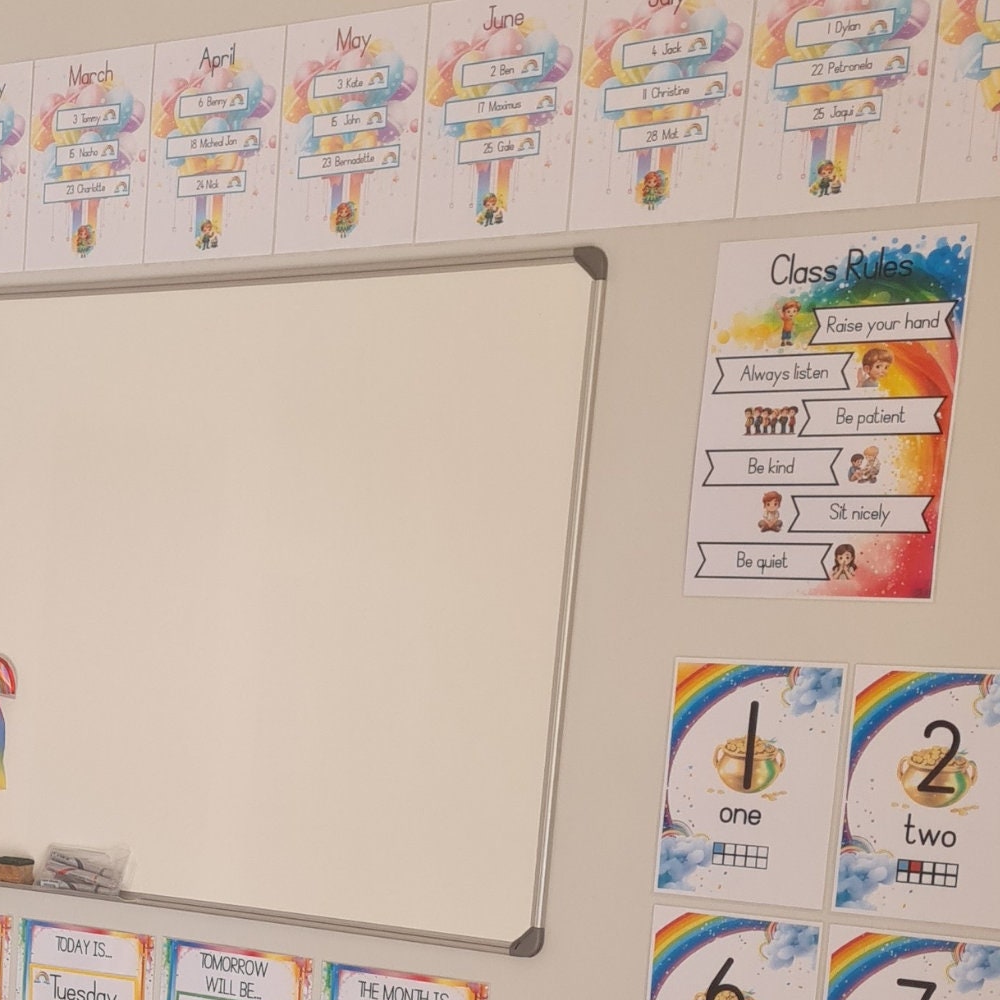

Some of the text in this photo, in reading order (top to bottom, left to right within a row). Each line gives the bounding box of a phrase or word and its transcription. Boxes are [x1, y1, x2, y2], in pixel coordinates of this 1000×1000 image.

[483, 5, 524, 31] June
[835, 20, 861, 36] Dylan
[336, 26, 371, 57] May
[661, 44, 682, 56] Jack
[199, 43, 236, 77] April
[811, 59, 873, 76] 22 Petronela
[69, 60, 113, 87] March
[491, 65, 514, 76] 2 Ben
[337, 77, 363, 89] 3 Kate
[651, 85, 690, 98] Christine
[206, 97, 226, 109] Benny
[489, 100, 522, 111] Maximus
[73, 113, 100, 125] 3 Tommy
[343, 115, 361, 125] John
[813, 108, 825, 120] 25
[646, 130, 658, 142] 28
[322, 154, 375, 168] 23 Bernadette
[206, 180, 219, 189] Nick
[771, 247, 913, 286] Class Rules
[826, 312, 940, 338] Raise your hand
[740, 366, 829, 387] Always listen
[835, 406, 906, 431] Be patient
[748, 458, 795, 474] Be kind
[830, 504, 891, 527] Sit nicely
[737, 552, 788, 575] Be quiet
[743, 701, 759, 790] 1
[917, 720, 961, 794] 2
[719, 807, 762, 825] one
[904, 813, 957, 847] two
[56, 936, 90, 956] TODAY
[200, 952, 268, 977] TOMORROW
[206, 976, 236, 996] WILL
[358, 981, 379, 998] THE
